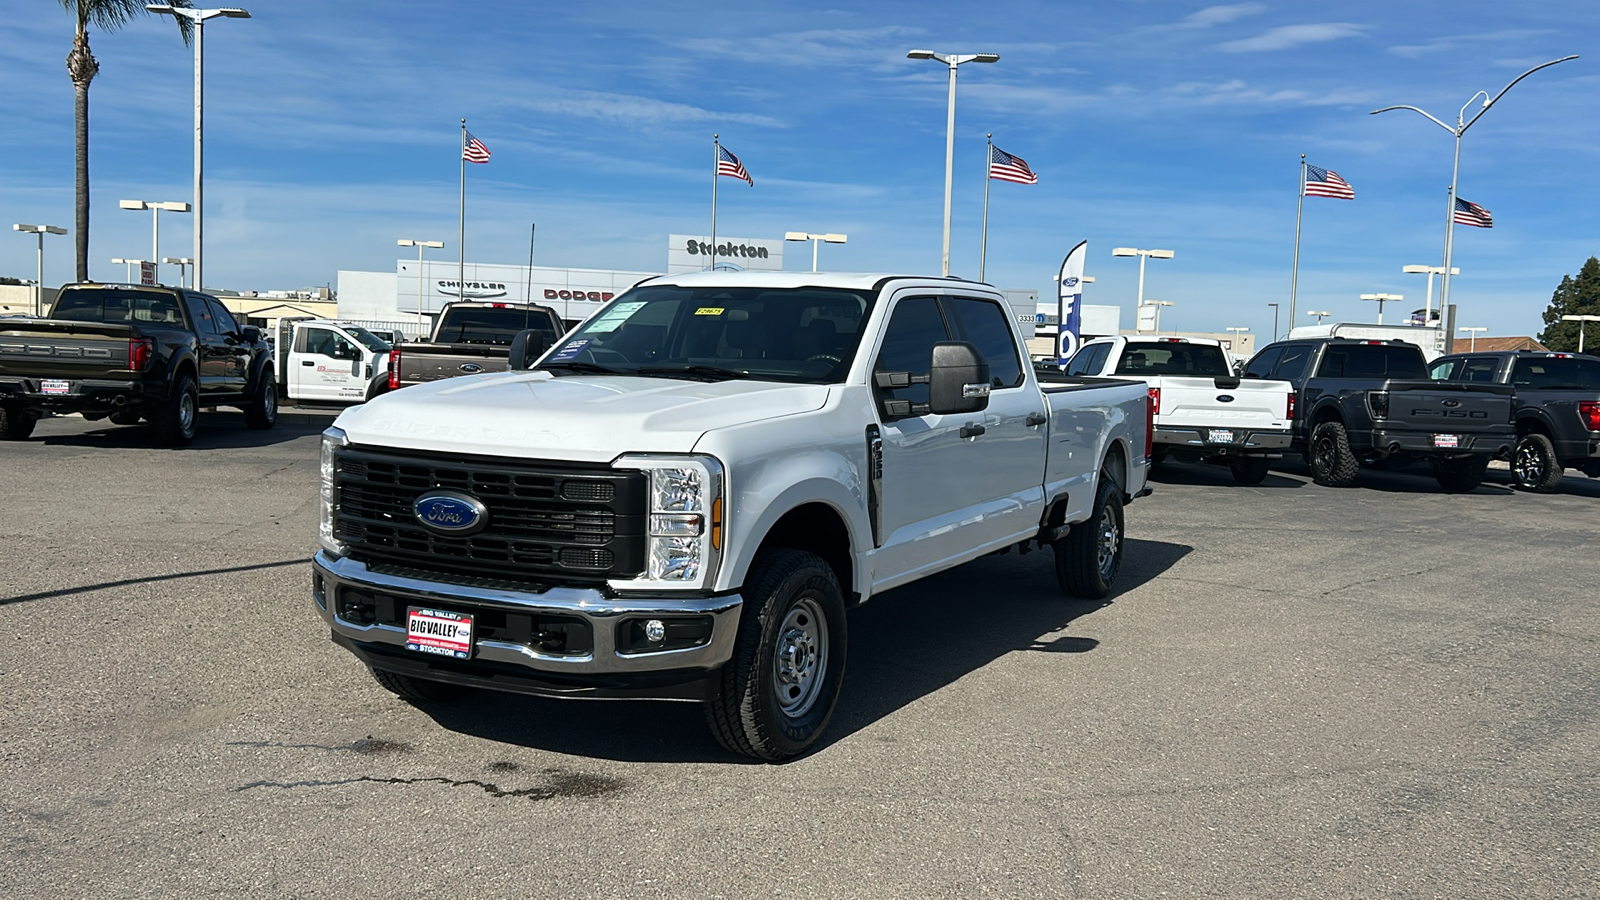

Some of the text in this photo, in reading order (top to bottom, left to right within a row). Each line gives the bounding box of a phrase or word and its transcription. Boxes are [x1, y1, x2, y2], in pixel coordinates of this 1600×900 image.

[686, 239, 769, 259] Stockton
[544, 289, 615, 302] DODGE
[1059, 296, 1077, 366] FO
[1411, 409, 1488, 419] F-150
[434, 611, 457, 619] VALLEY
[419, 645, 455, 656] STOCKTON
